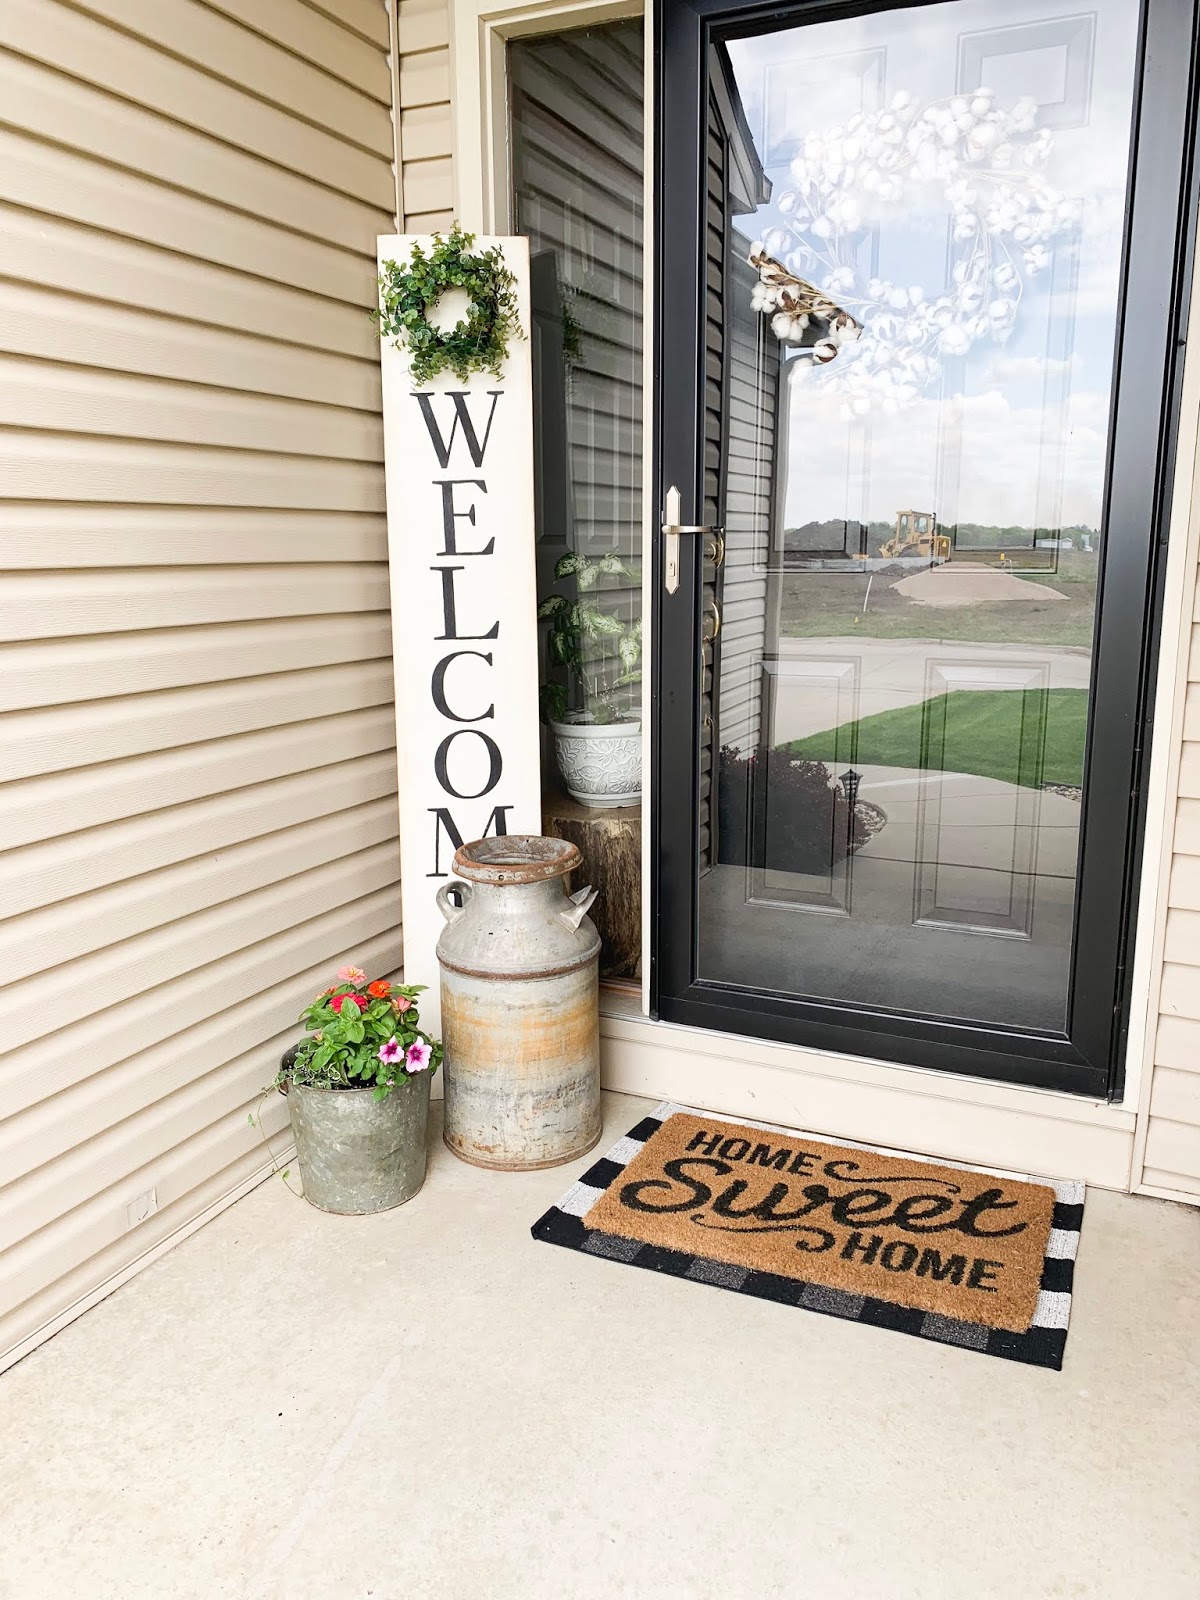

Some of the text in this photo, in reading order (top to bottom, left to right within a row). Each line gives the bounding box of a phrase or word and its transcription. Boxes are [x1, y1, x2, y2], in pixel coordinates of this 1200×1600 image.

[409, 390, 514, 908] WELCOM
[685, 1130, 822, 1177] HOME
[619, 1157, 1027, 1238] Sweet
[841, 1231, 1004, 1294] HOME
